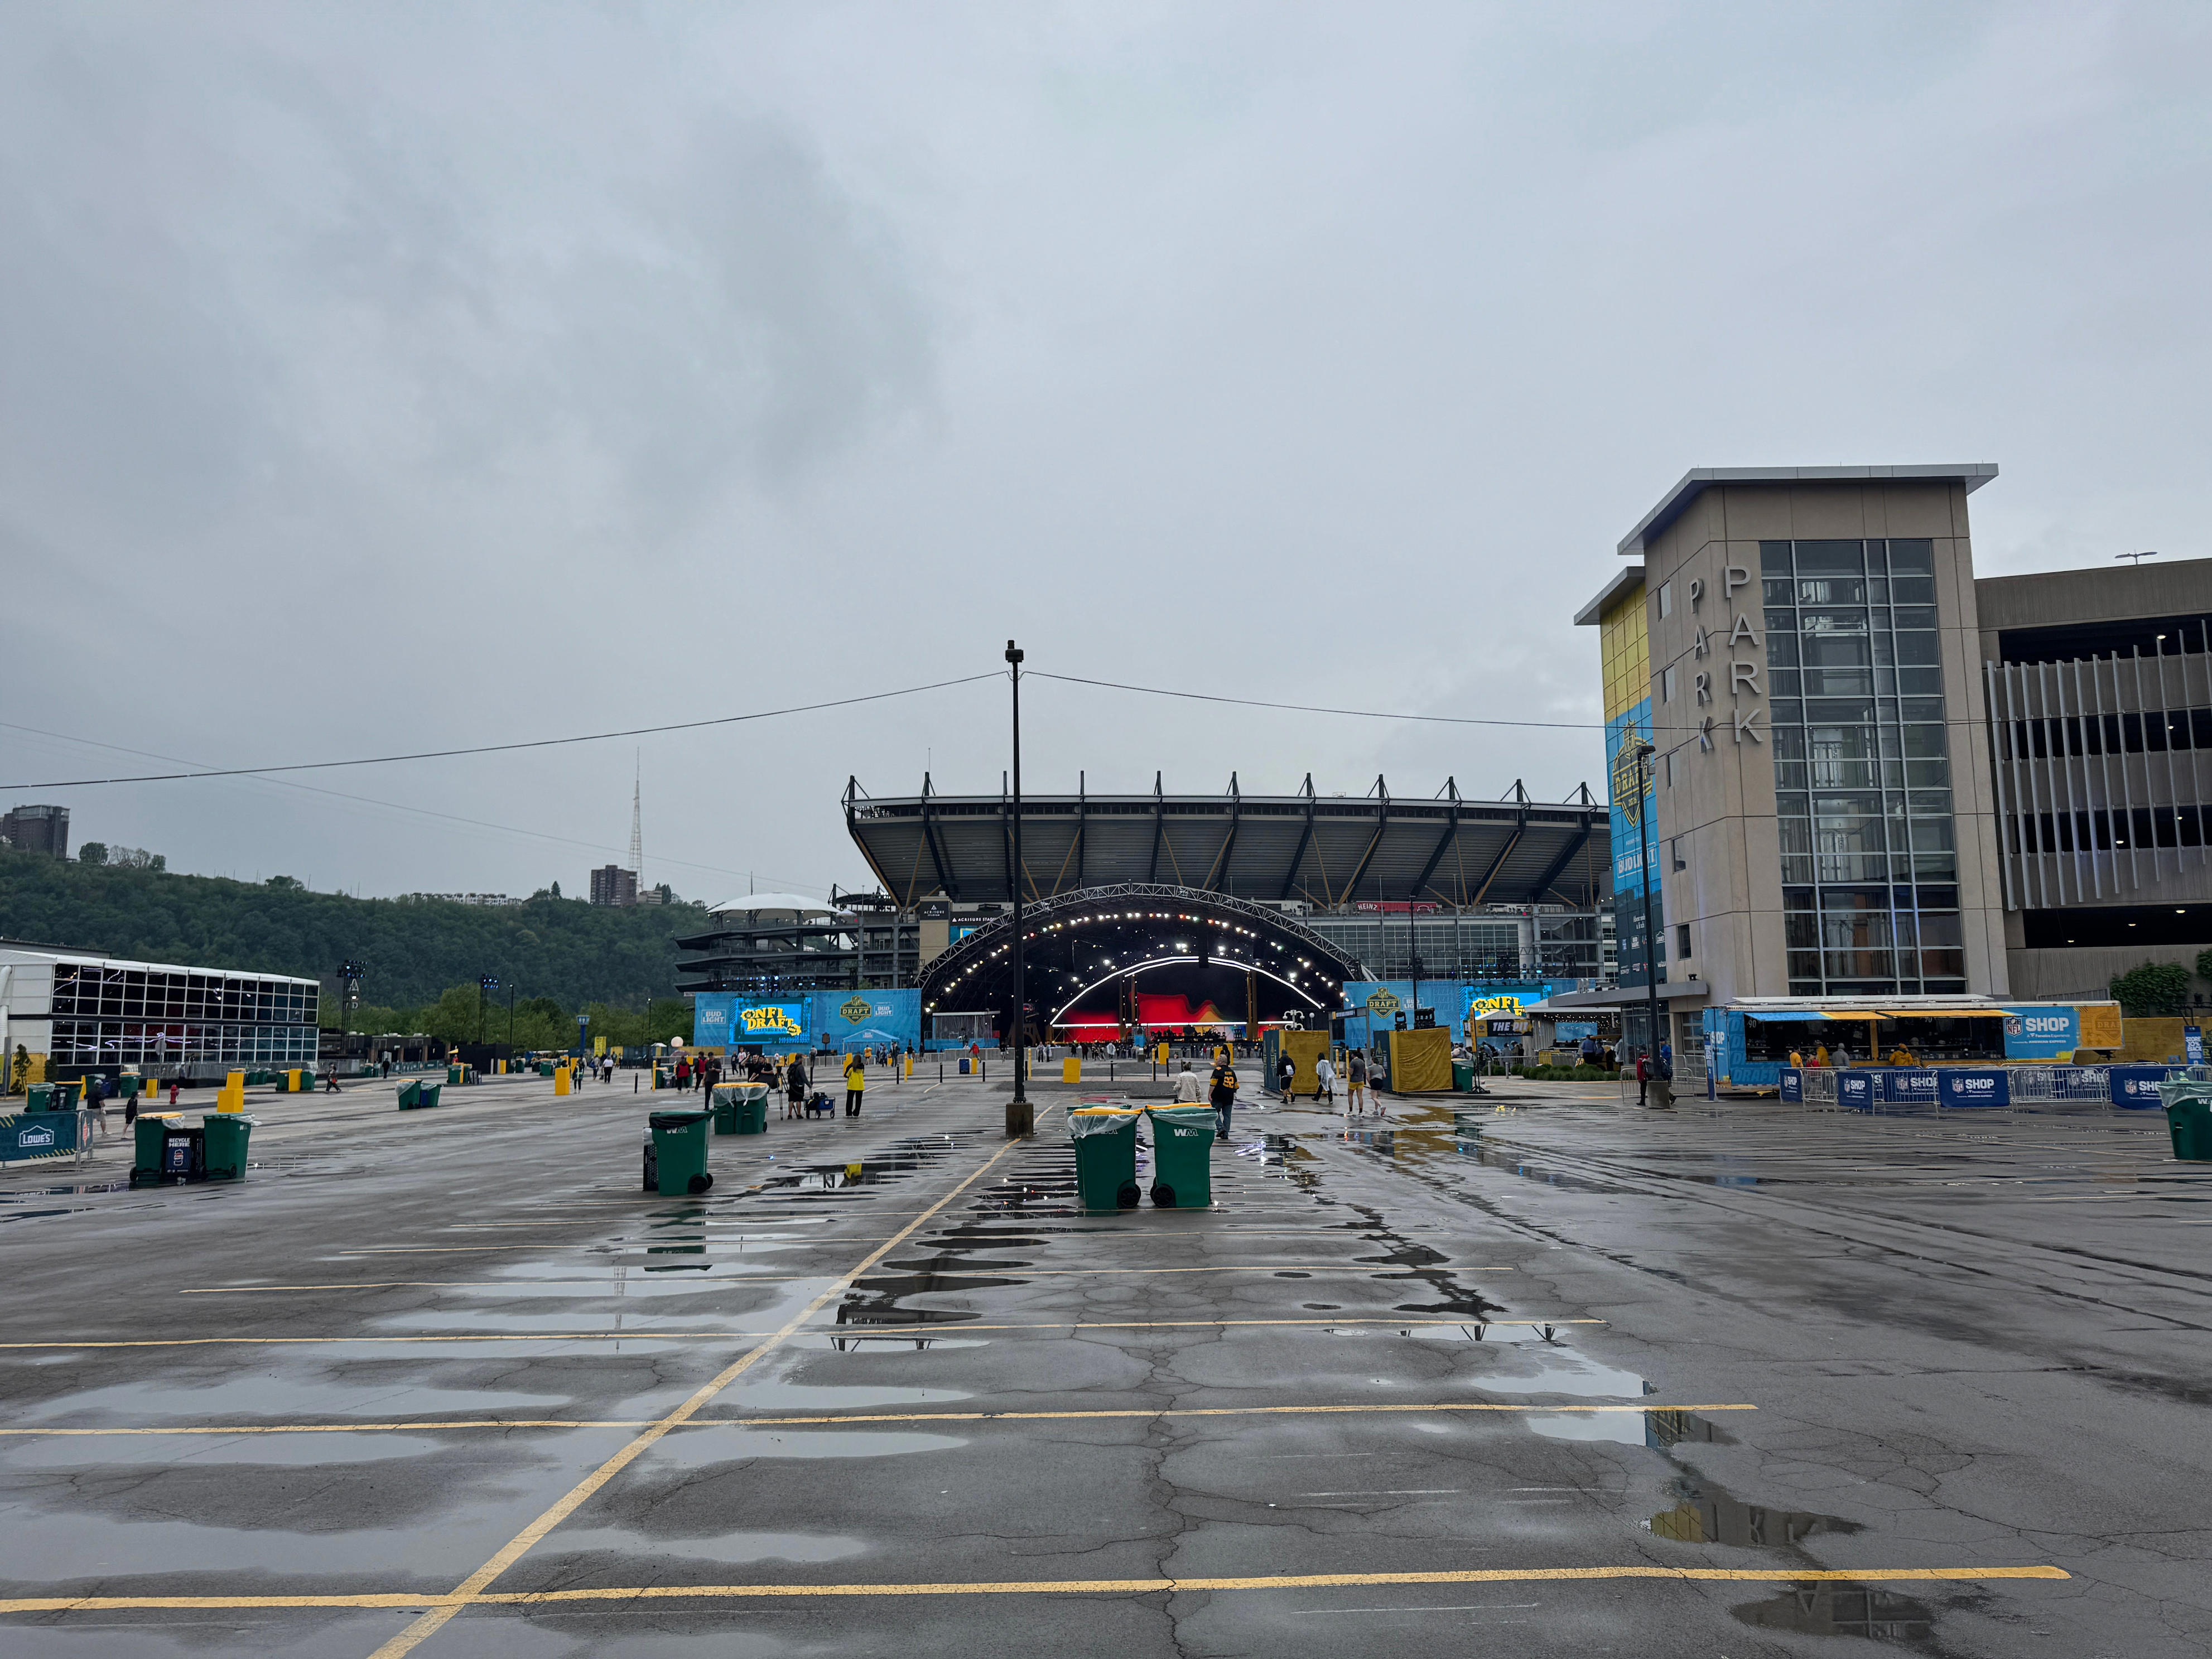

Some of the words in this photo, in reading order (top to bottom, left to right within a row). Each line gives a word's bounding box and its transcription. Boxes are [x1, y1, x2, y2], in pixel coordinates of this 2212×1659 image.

[1724, 565, 1763, 742] PARK
[1689, 577, 1714, 754] PARK
[1618, 856, 1633, 874] BUD
[1487, 996, 1524, 1009] NFL
[755, 1007, 787, 1019] NFL
[746, 1019, 794, 1031] DRAFT
[1493, 1022, 1511, 1031] THE
[1512, 1021, 1529, 1031] PIT
[2026, 1017, 2069, 1031] SHOP
[1788, 1077, 1797, 1086] SHOP
[1850, 1080, 1866, 1089] SHOP
[1965, 1078, 1994, 1089] SHOP
[666, 1126, 688, 1134] WM
[1174, 1128, 1199, 1137] WM
[23, 1132, 51, 1144] LOWE'S
